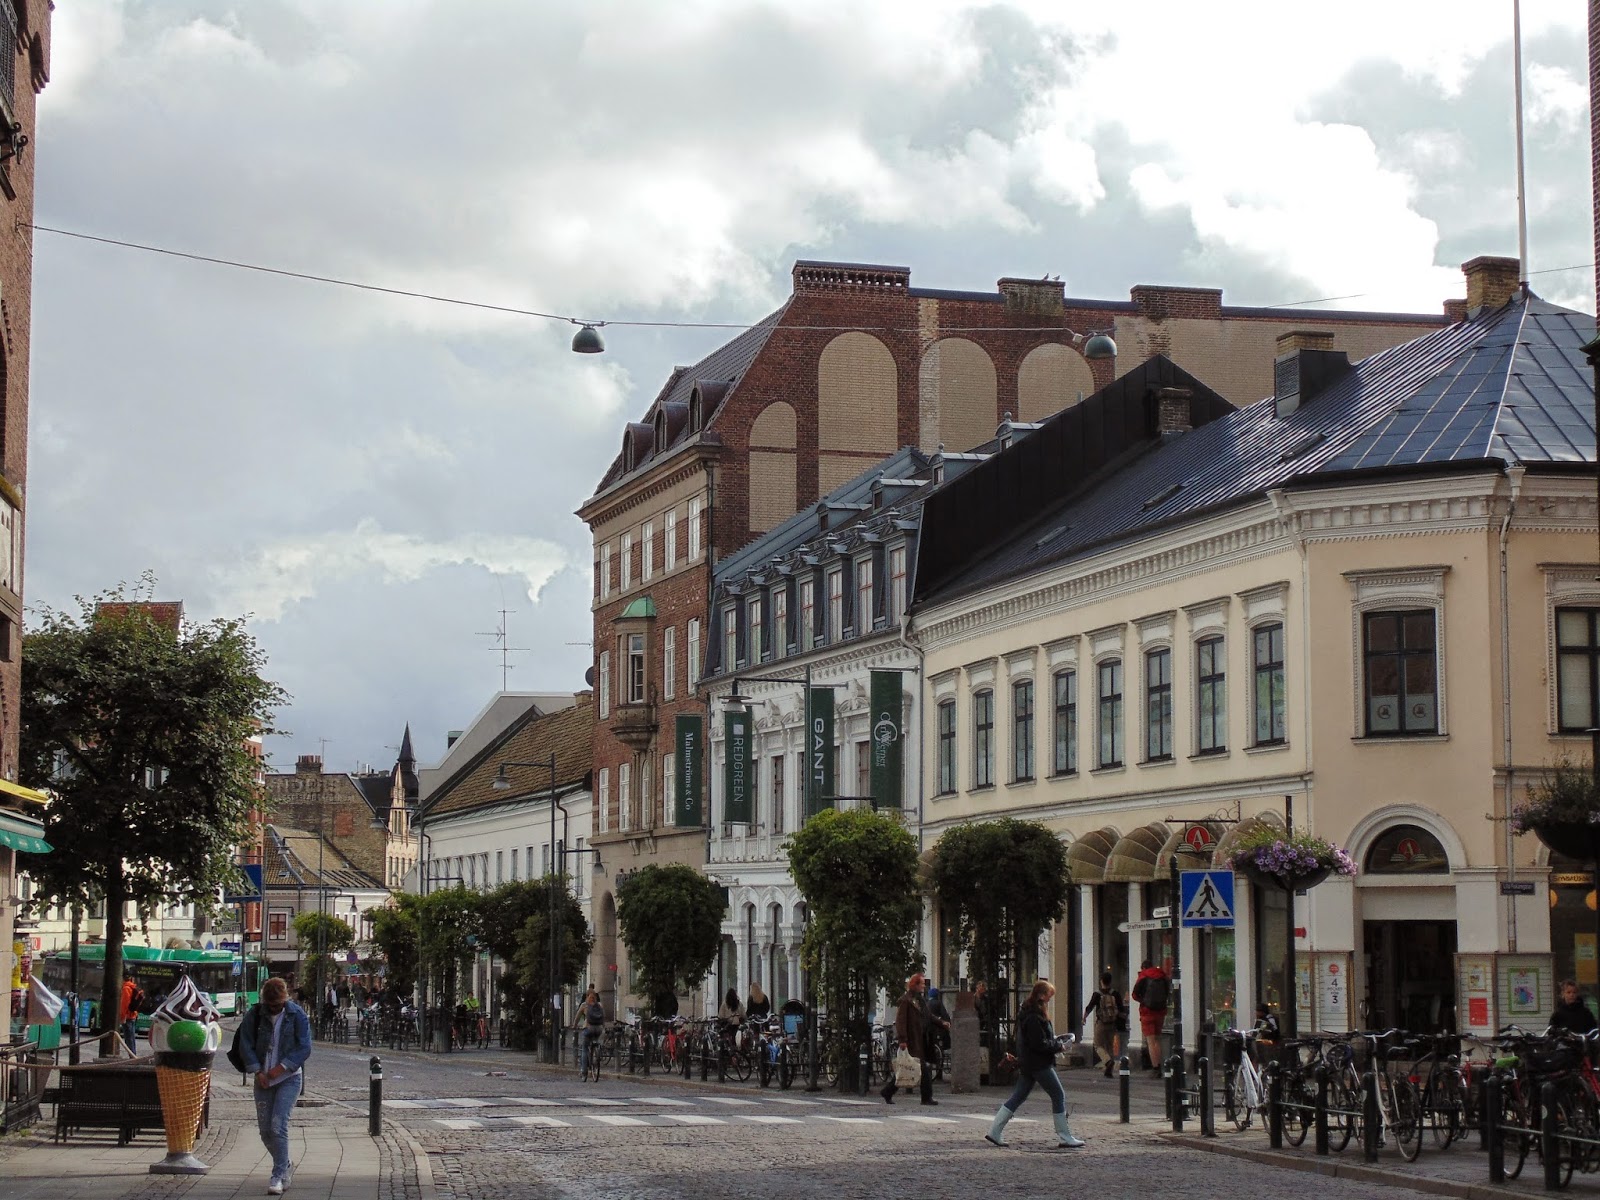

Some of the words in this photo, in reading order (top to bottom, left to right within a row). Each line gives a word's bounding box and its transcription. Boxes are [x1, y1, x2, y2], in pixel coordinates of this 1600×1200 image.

[685, 732, 694, 788] Malmströms
[814, 717, 824, 785] GANT
[733, 737, 744, 802] REDGREEN
[685, 797, 694, 811] Co
[1331, 978, 1338, 987] 4
[1332, 995, 1338, 1004] 3
